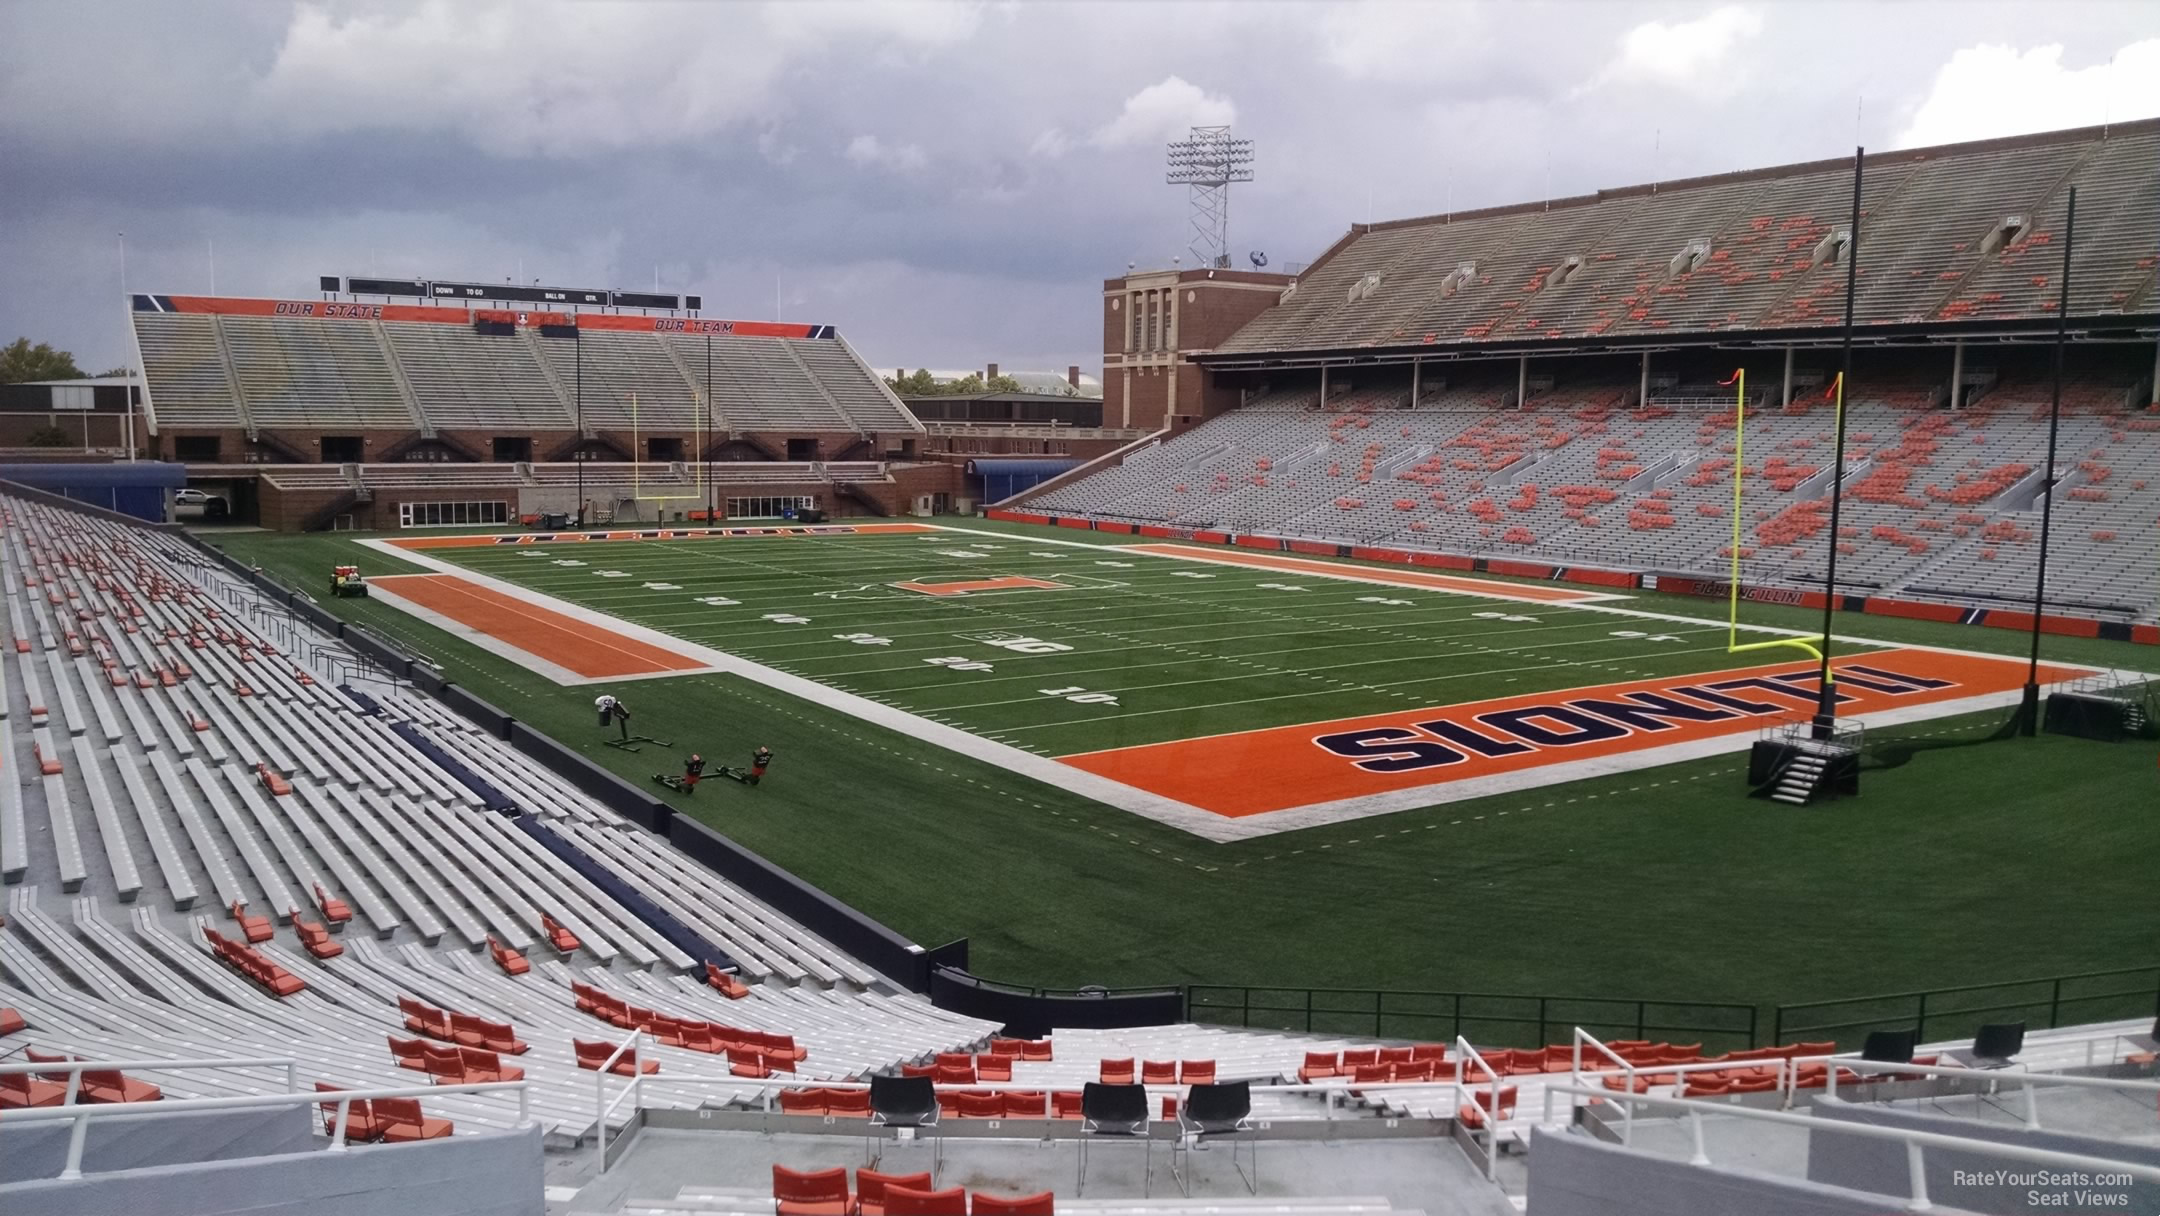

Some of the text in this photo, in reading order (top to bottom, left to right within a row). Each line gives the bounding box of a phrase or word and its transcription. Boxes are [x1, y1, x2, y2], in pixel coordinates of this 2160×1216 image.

[435, 287, 454, 295] DOWN
[545, 292, 566, 301] BALL ON
[275, 302, 384, 319] OUR STATE
[655, 318, 735, 334] OUR TEAM
[1758, 589, 1805, 606] ILLINI
[921, 656, 994, 672] 20
[1036, 686, 1119, 704] 10
